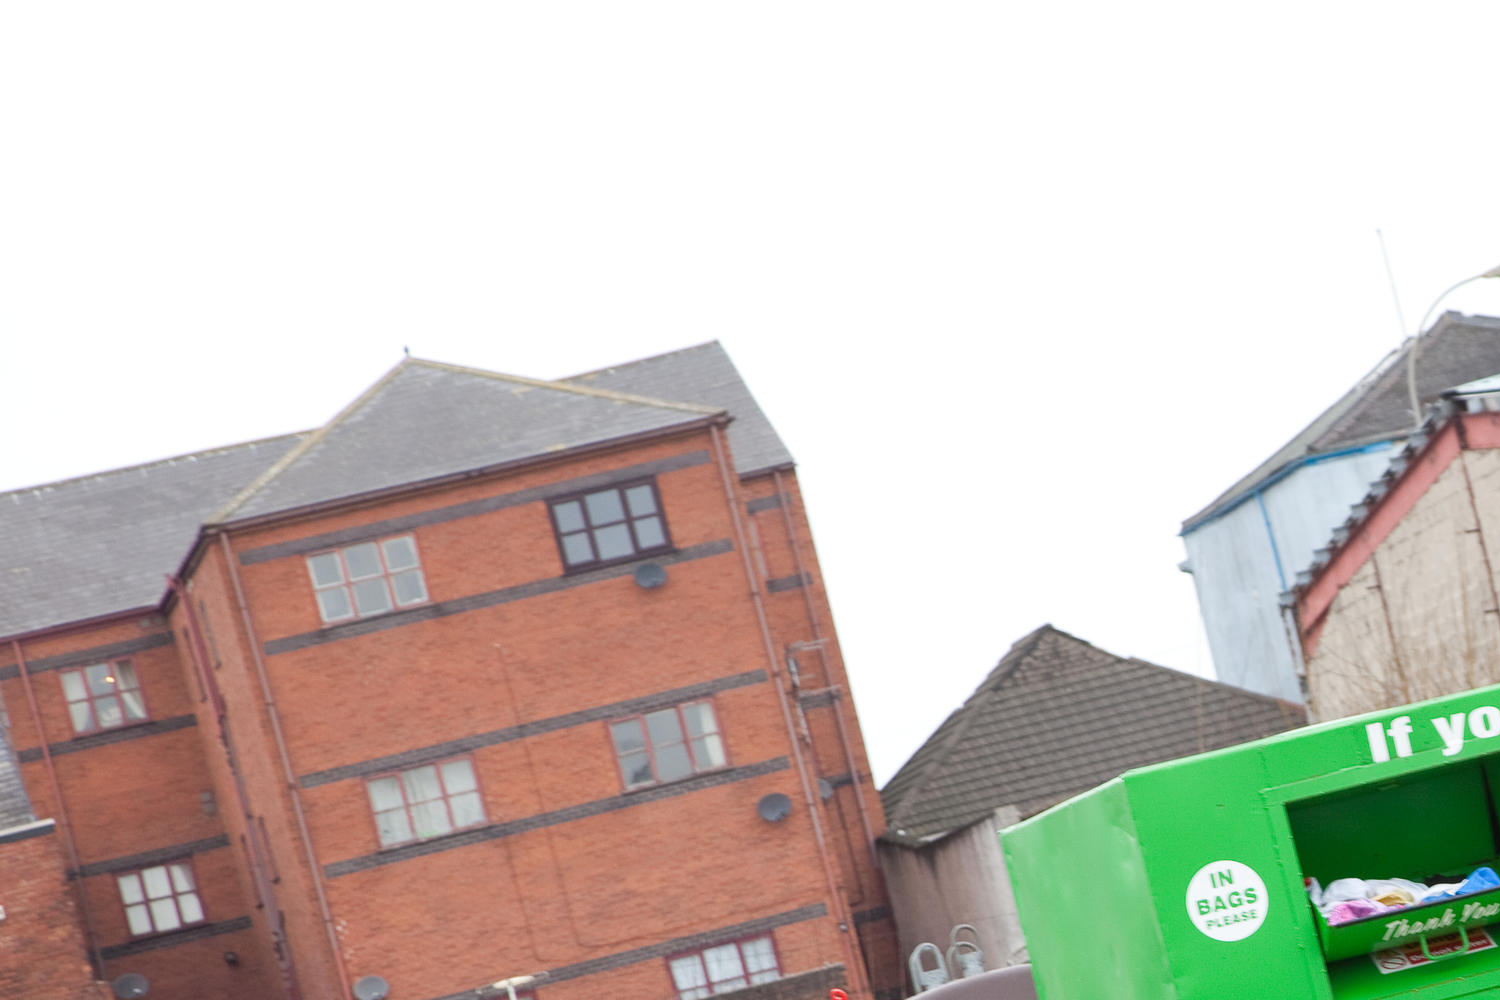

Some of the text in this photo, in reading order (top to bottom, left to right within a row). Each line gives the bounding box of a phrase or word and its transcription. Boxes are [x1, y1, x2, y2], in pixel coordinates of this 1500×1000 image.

[1364, 715, 1413, 763] If
[1210, 868, 1234, 889] IN
[1197, 887, 1257, 915] BAGS
[1206, 909, 1257, 930] PLEASE
[1382, 908, 1456, 941] Thank
[1459, 901, 1500, 923] You
